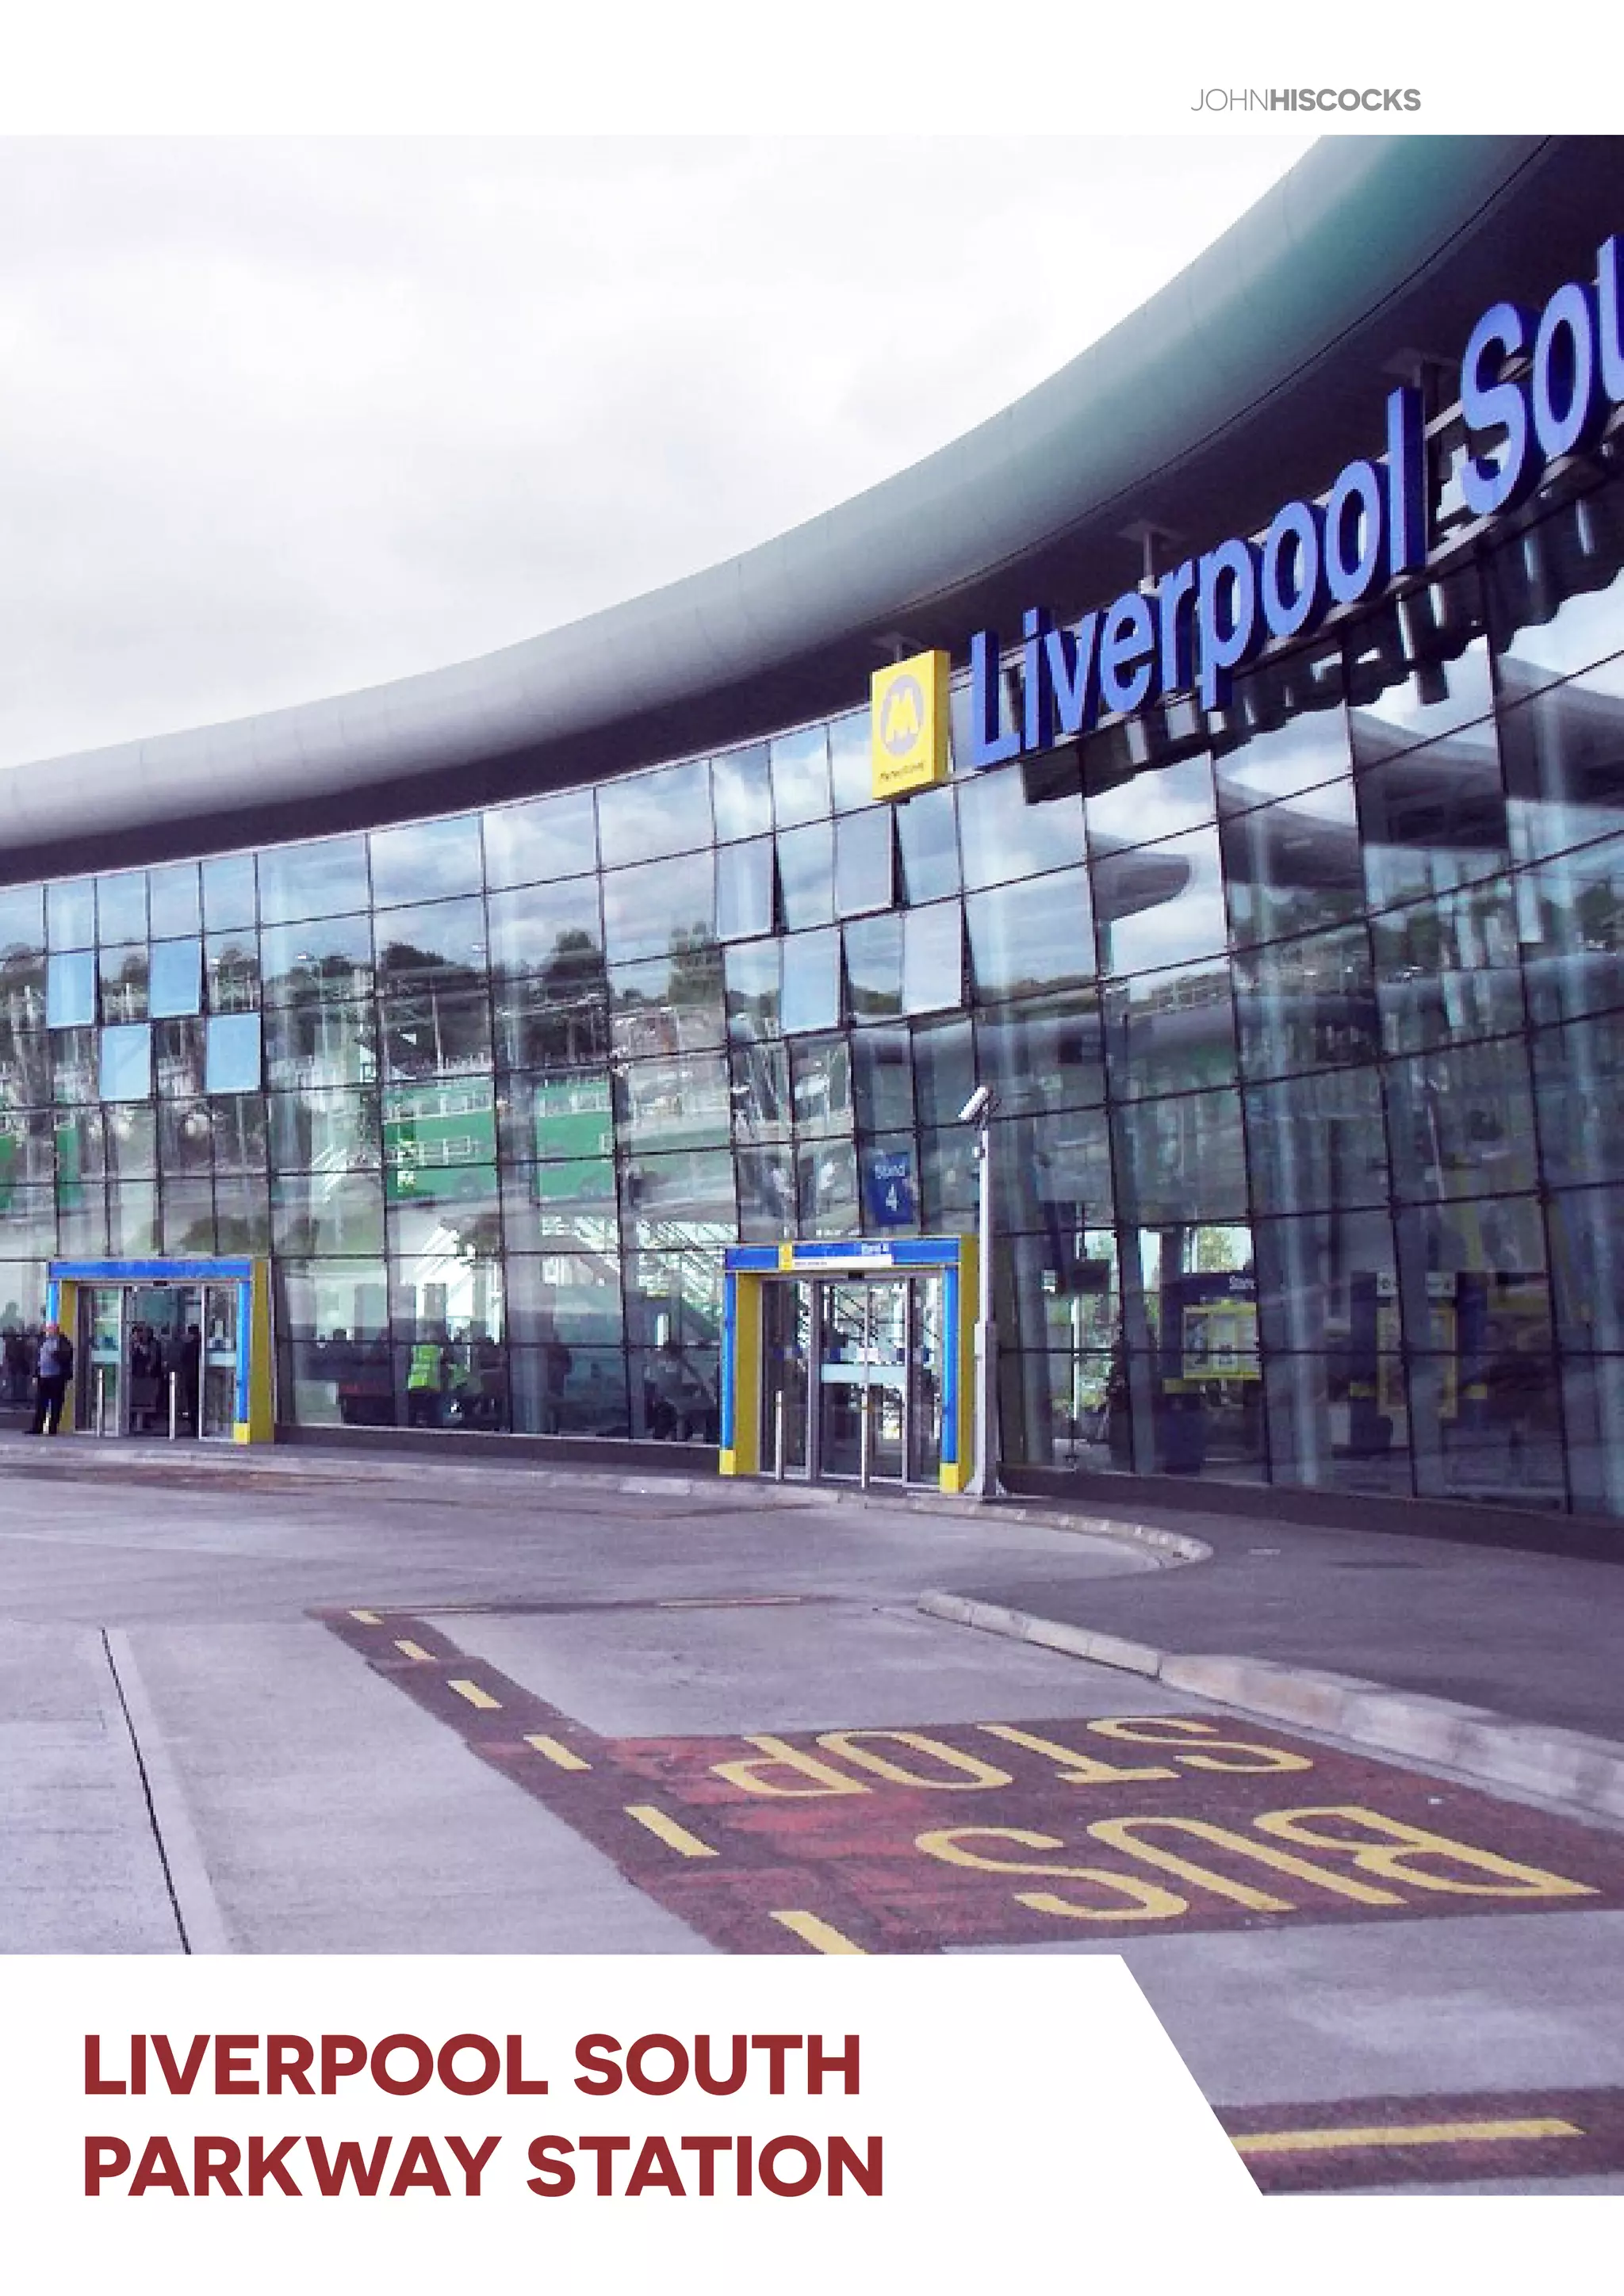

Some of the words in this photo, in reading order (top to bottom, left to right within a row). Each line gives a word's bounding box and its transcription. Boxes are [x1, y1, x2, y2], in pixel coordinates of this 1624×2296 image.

[966, 387, 1408, 769] Liverpool
[885, 1184, 898, 1211] 4
[710, 1713, 1315, 1797] STOP
[914, 1805, 1600, 1921] BUS
